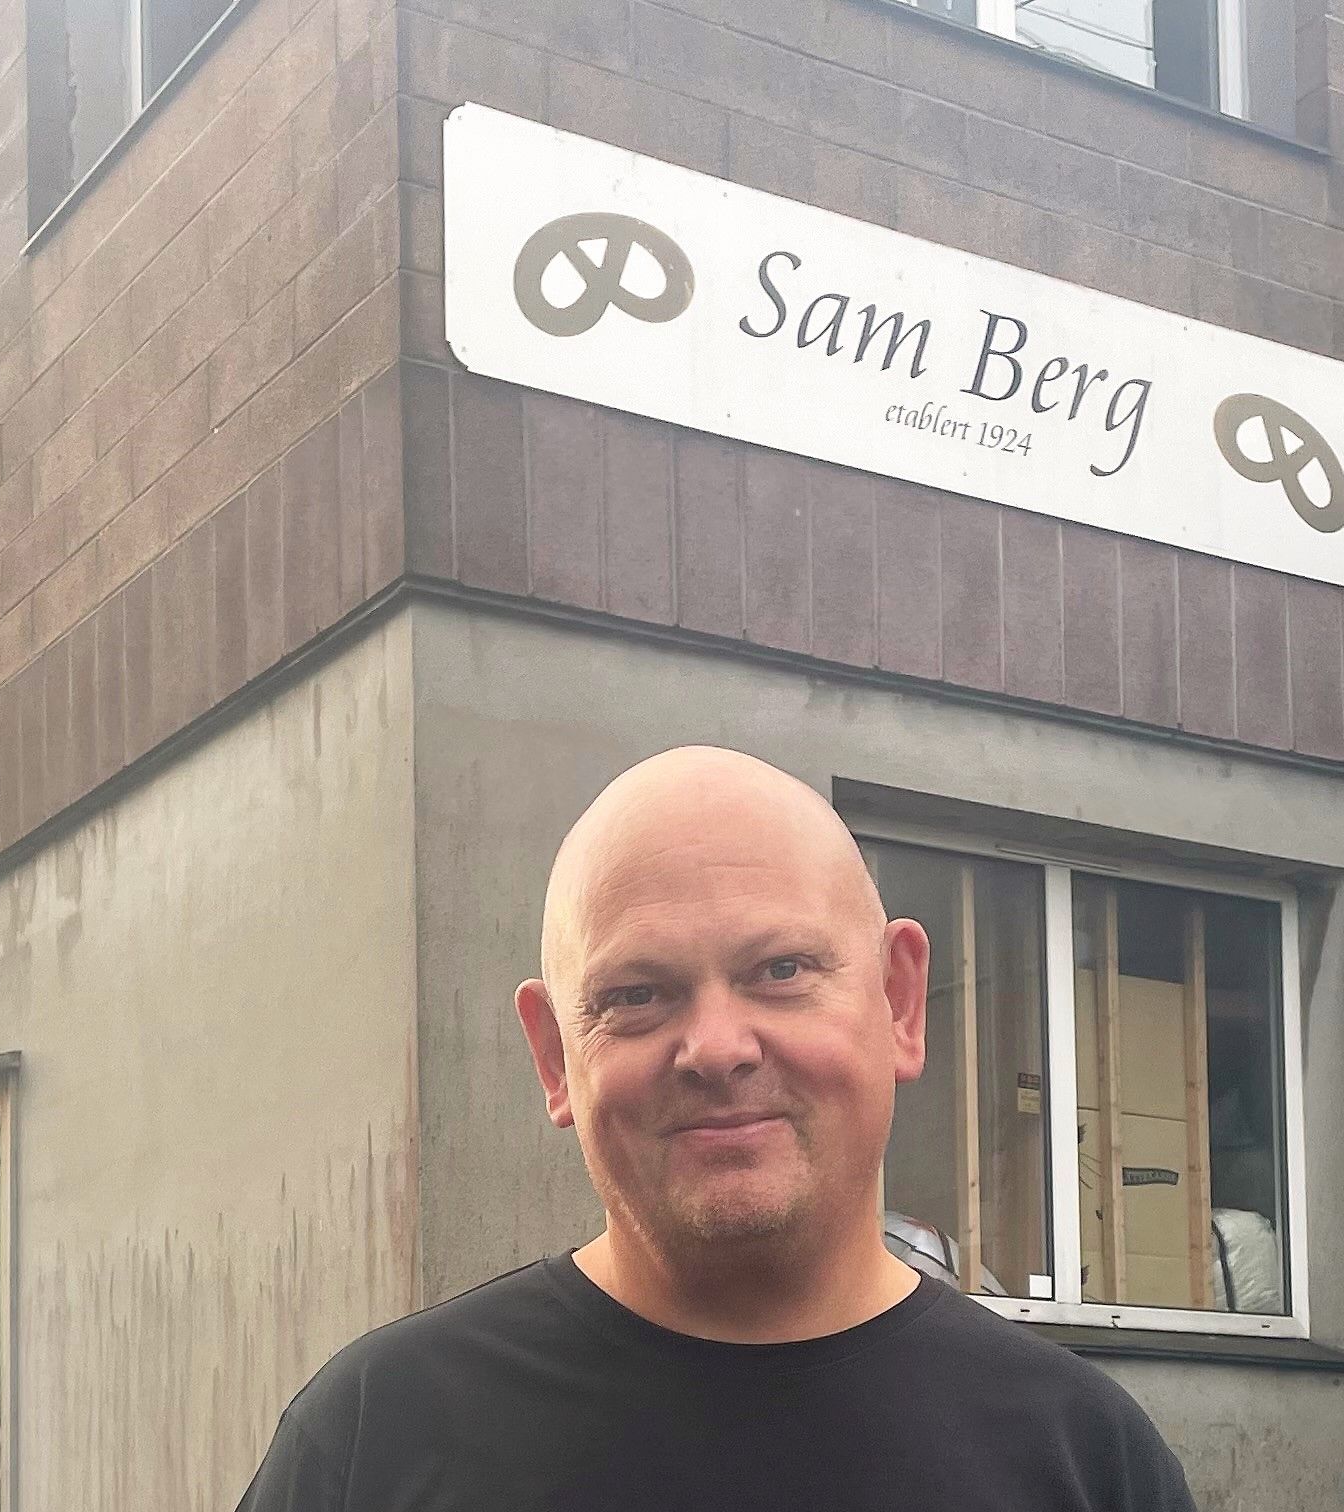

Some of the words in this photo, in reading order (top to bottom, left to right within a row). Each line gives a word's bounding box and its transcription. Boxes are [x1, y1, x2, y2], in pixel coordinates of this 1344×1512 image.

[739, 251, 931, 379] Sam
[959, 308, 1153, 477] Berg
[885, 401, 972, 440] etablert
[976, 422, 1033, 457] 1924
